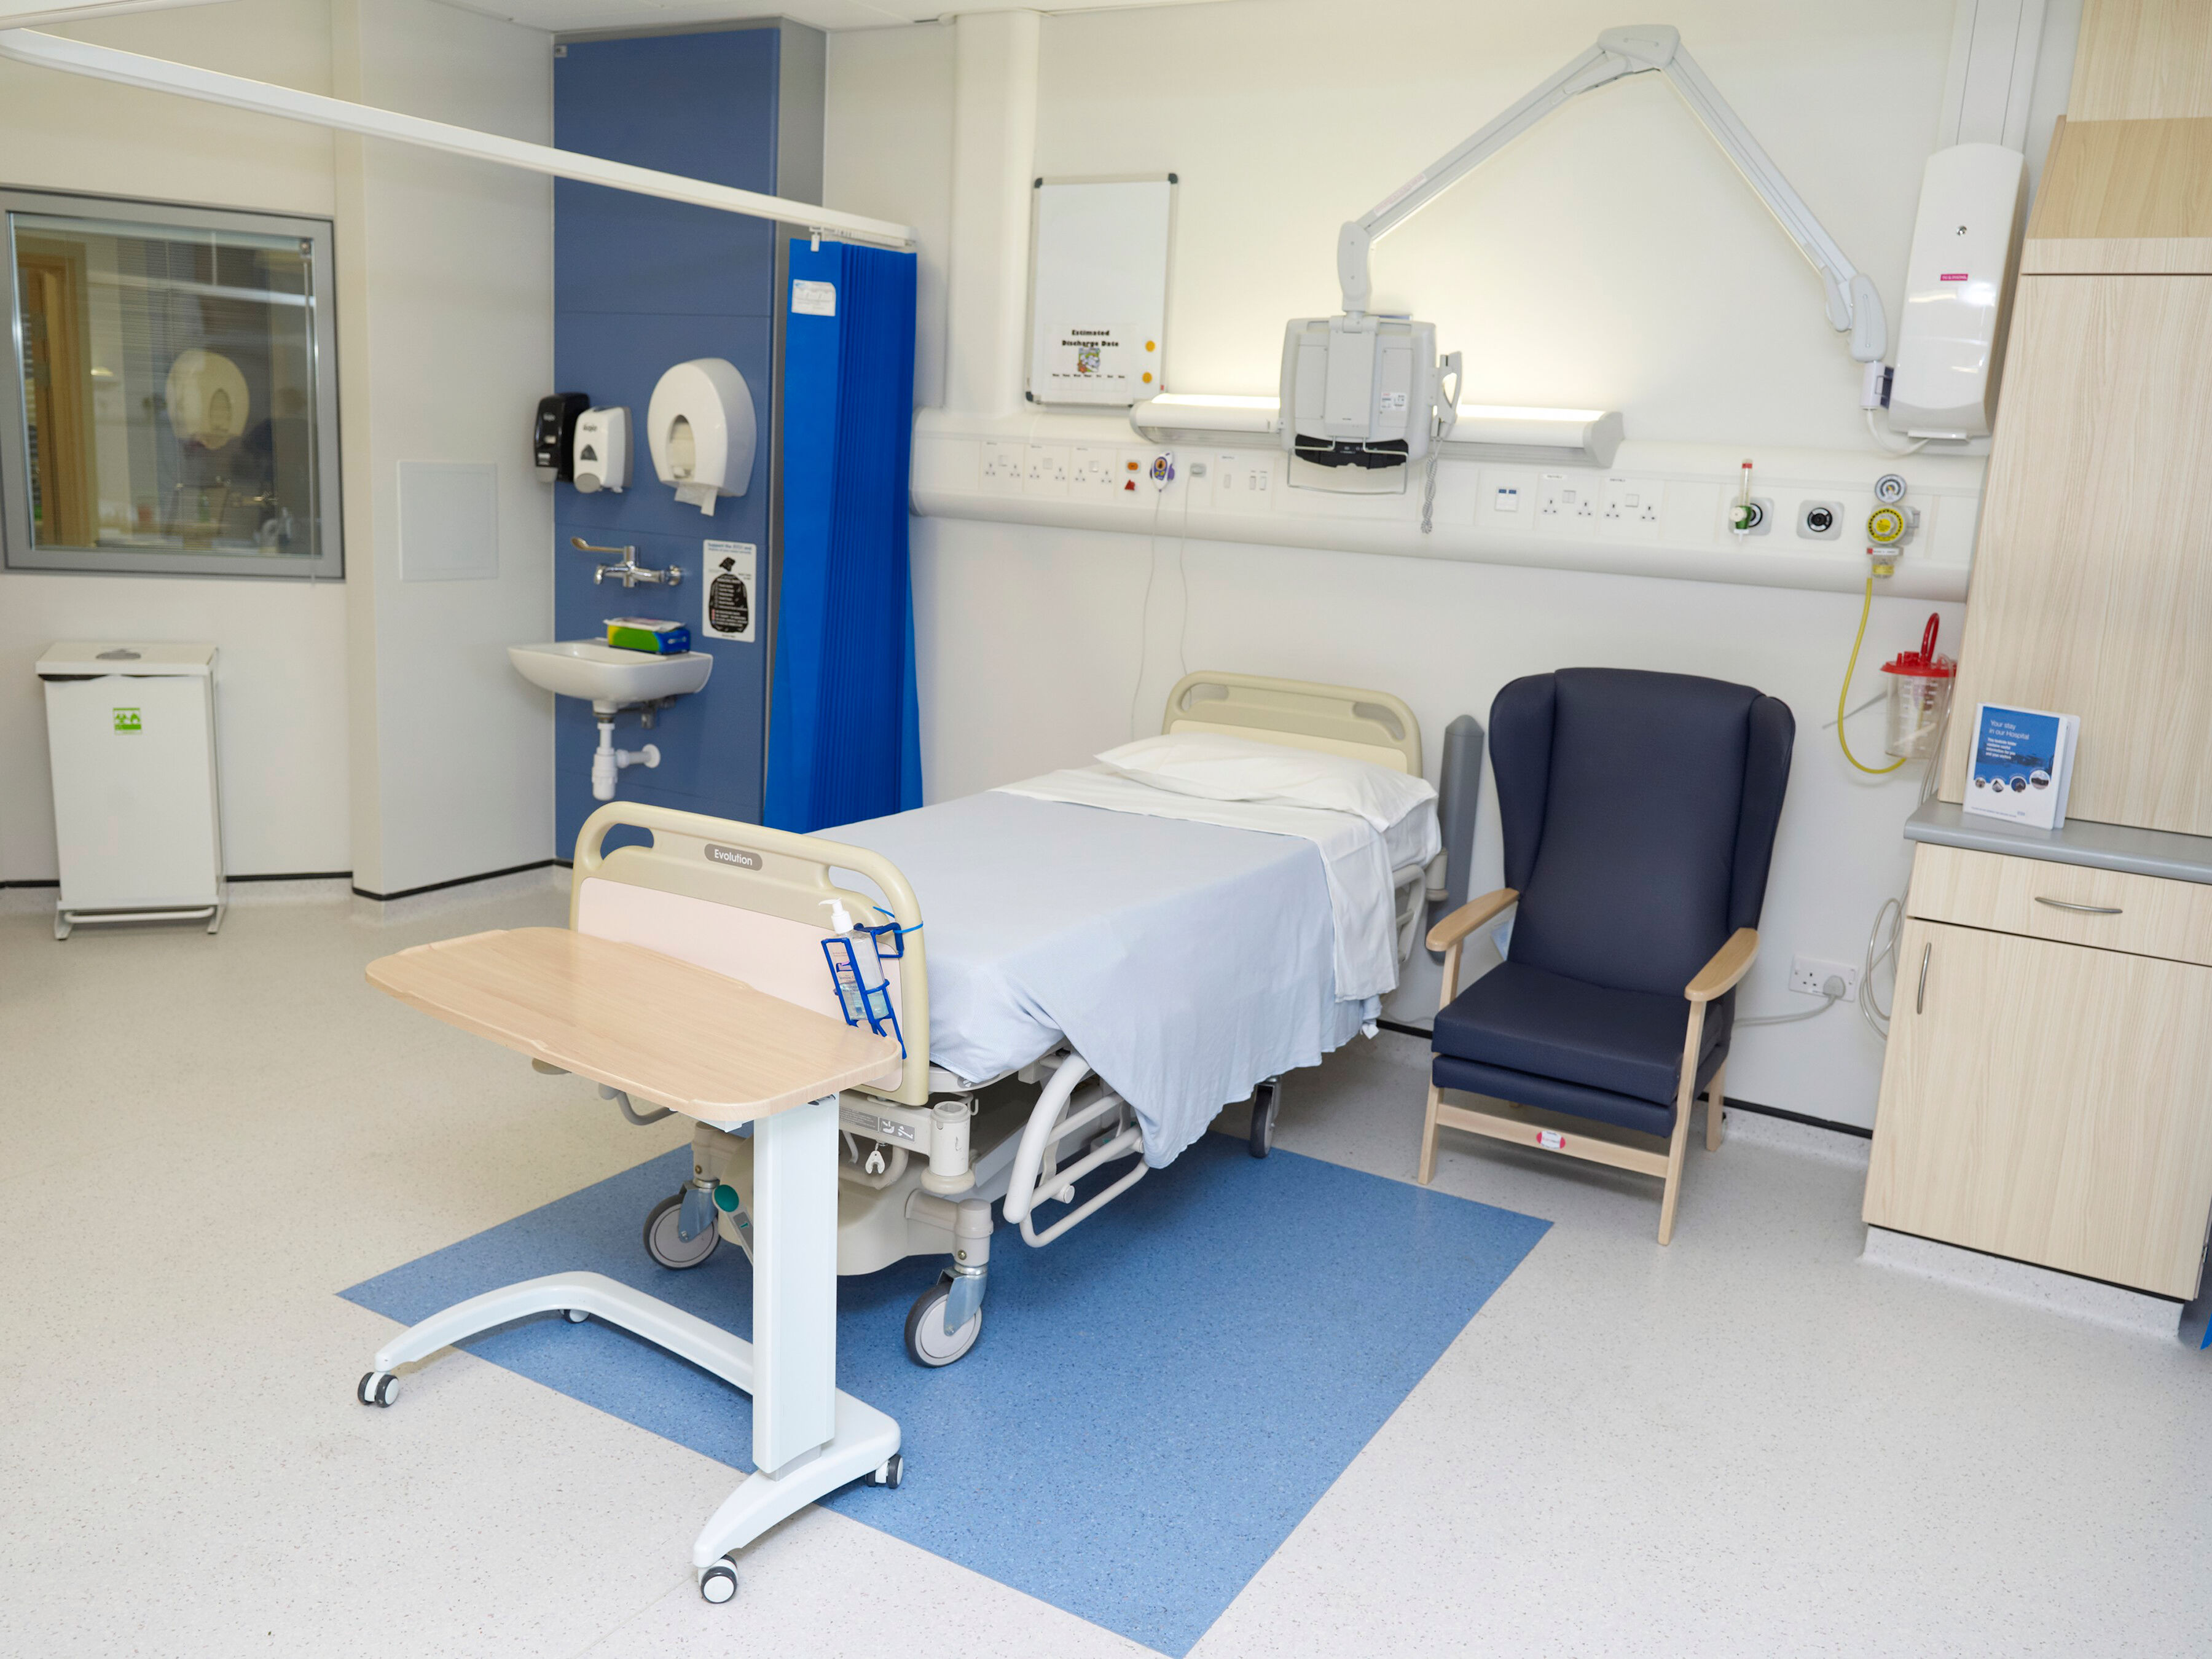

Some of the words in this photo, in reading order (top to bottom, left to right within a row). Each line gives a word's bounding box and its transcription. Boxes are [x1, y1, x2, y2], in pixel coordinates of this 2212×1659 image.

[1990, 719, 2003, 728] Your
[2004, 723, 2016, 731] stay
[2006, 731, 2030, 740] Hospital
[714, 849, 753, 866] Evolution
